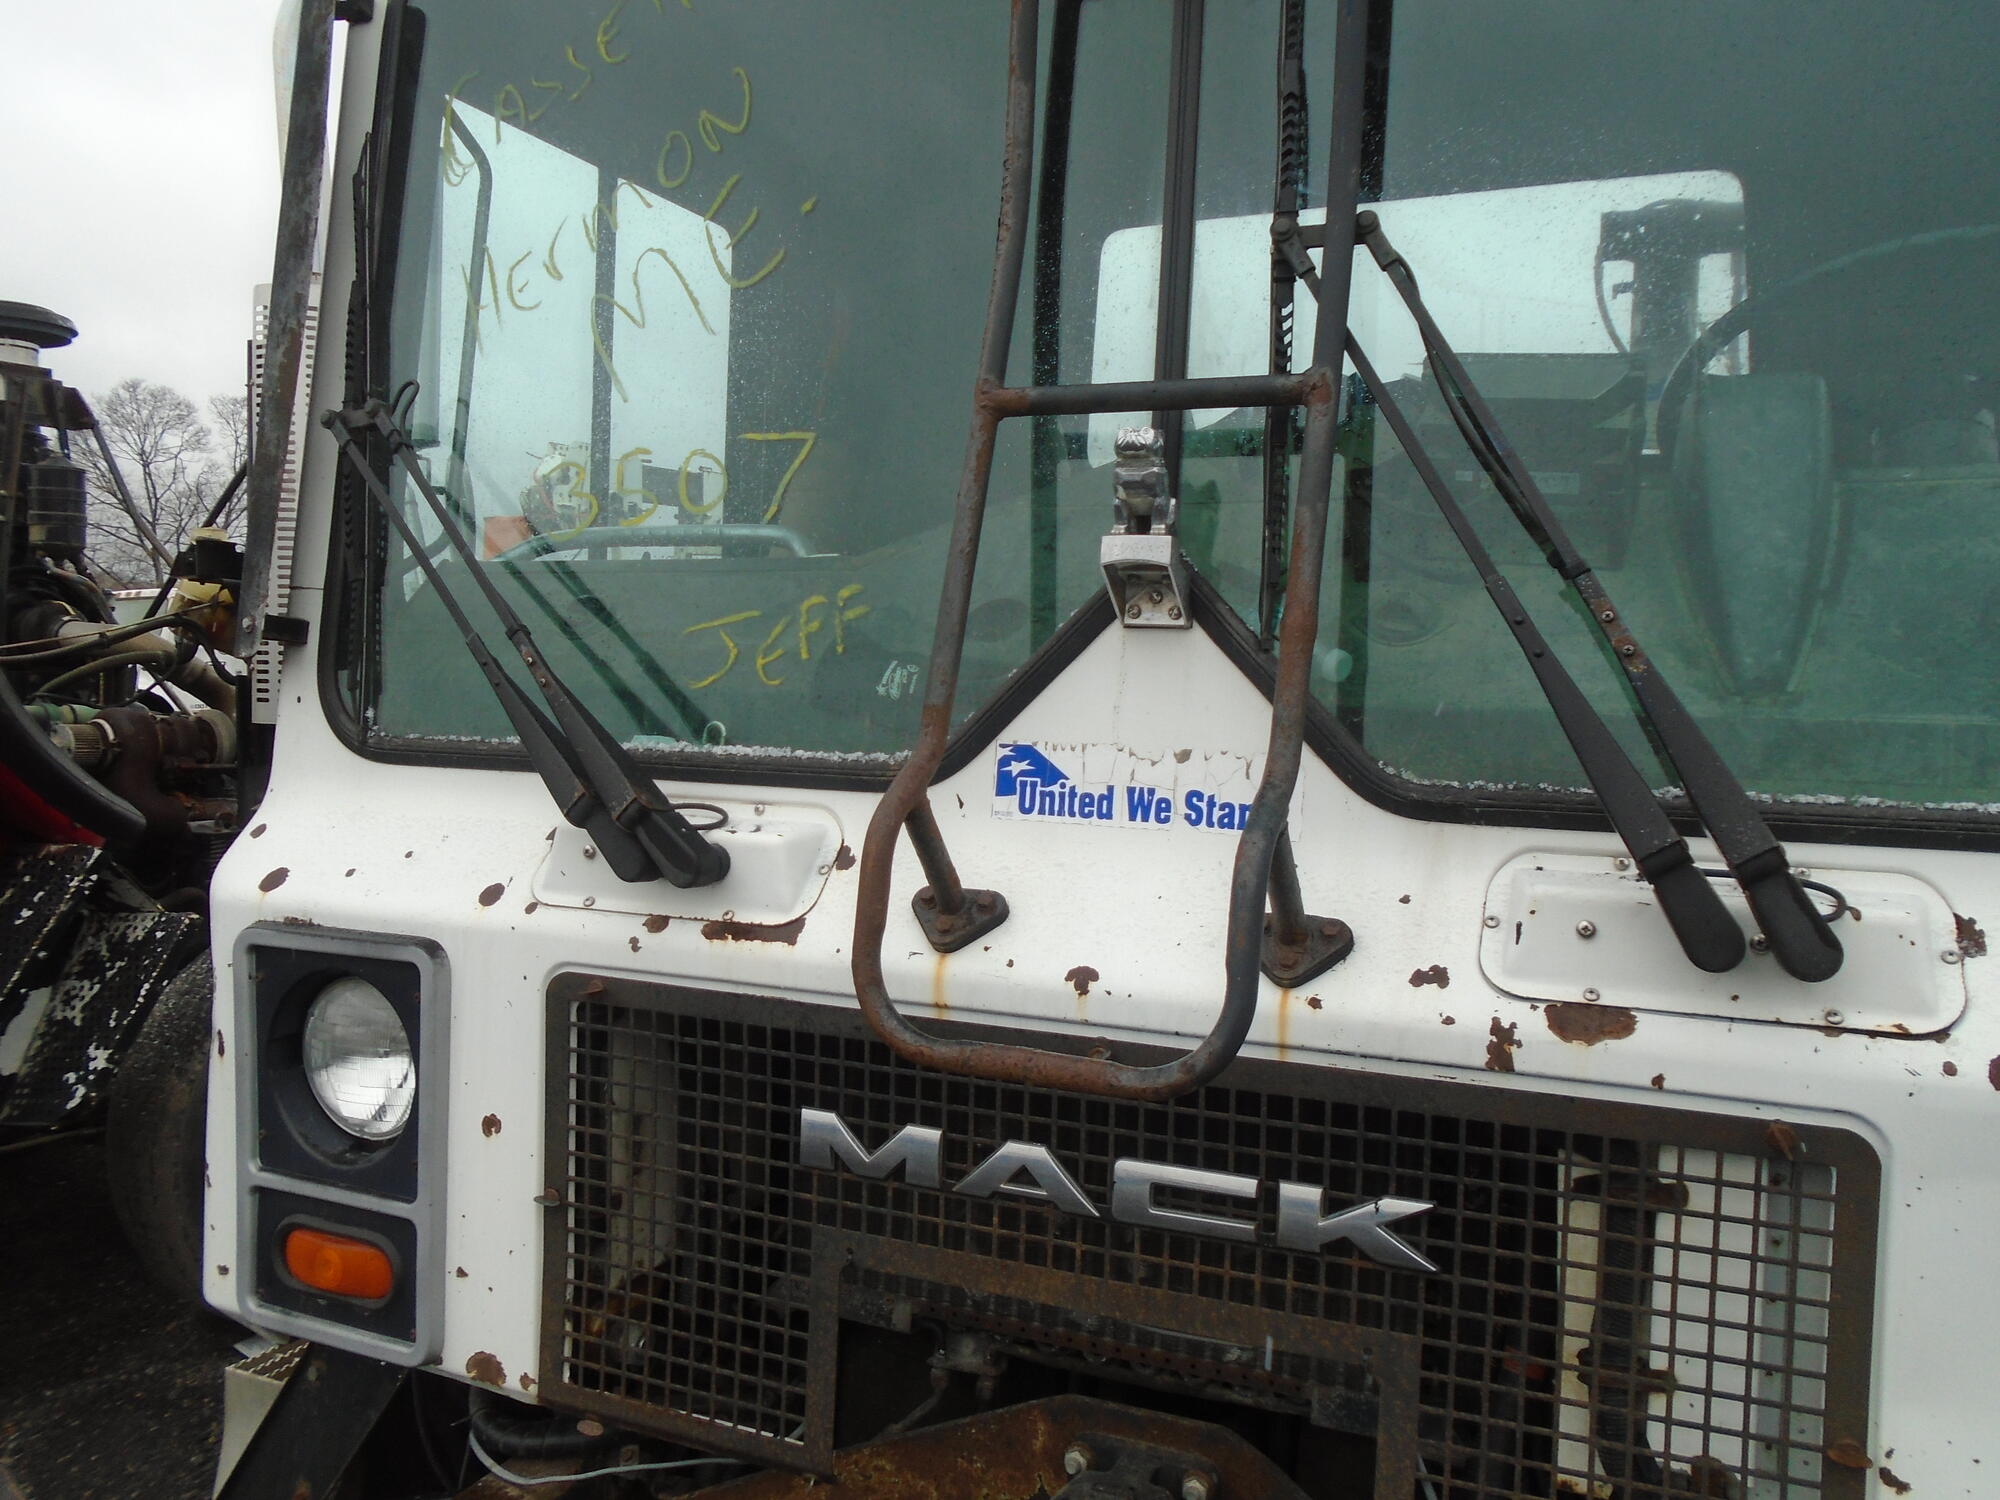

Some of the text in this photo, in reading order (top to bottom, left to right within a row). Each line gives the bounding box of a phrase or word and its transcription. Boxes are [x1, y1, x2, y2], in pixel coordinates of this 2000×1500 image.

[546, 431, 816, 541] 3507
[683, 583, 871, 689] JEFF
[1018, 778, 1114, 820] United
[1127, 786, 1172, 825] We
[801, 1108, 1438, 1272] MACK
